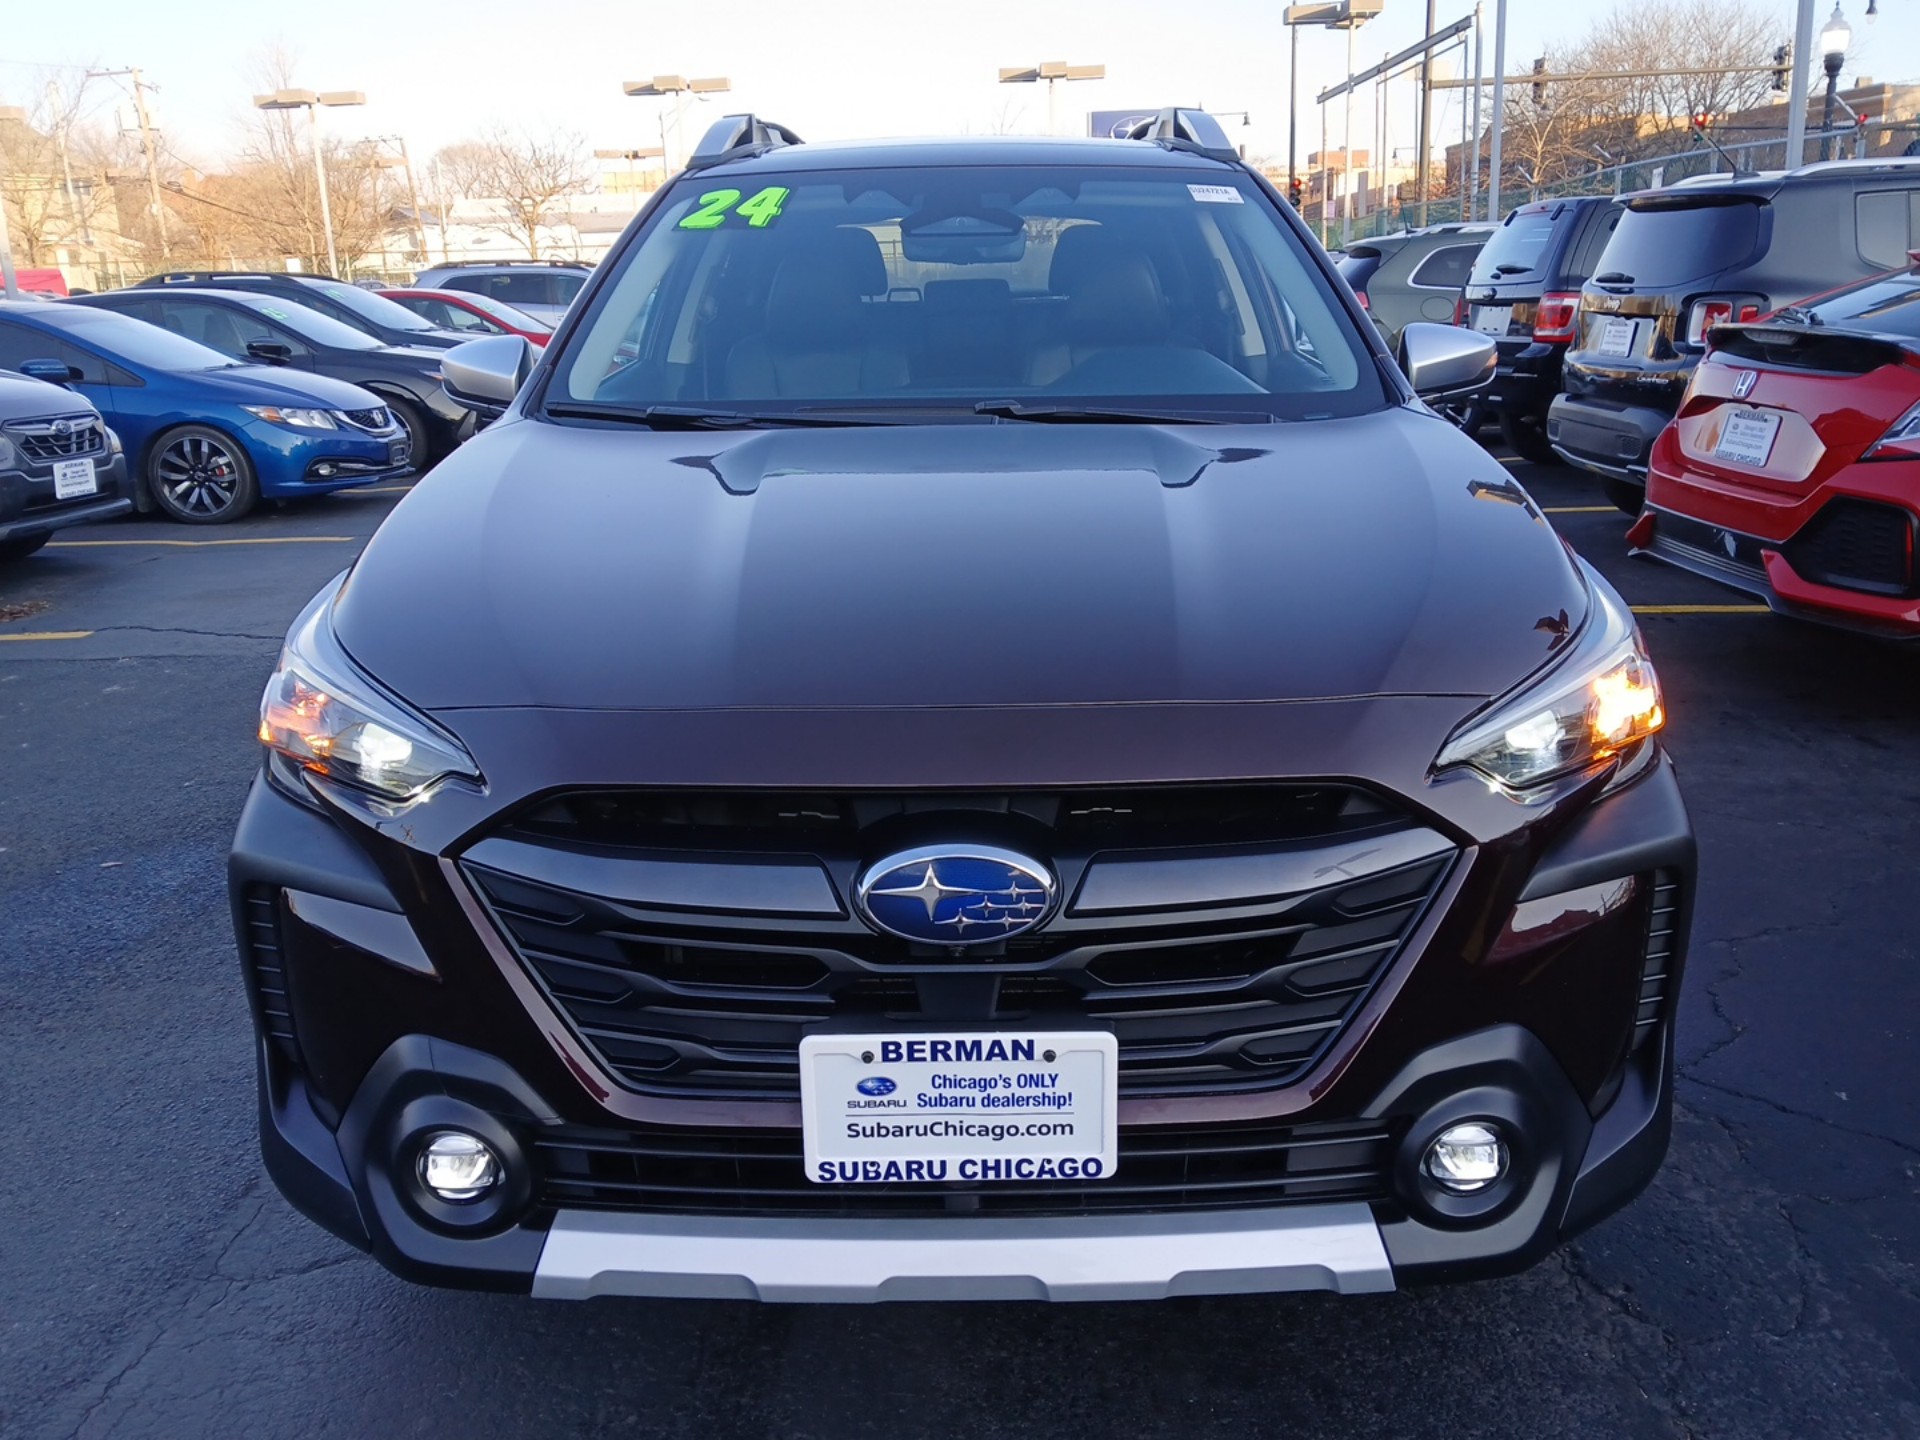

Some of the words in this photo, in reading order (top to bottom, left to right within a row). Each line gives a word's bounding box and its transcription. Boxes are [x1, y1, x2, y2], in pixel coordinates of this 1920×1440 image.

[679, 186, 790, 229] 24
[881, 1039, 1035, 1063] BERMAN
[931, 1074, 1011, 1093] Chicago's
[1016, 1073, 1059, 1089] ONLY
[847, 1100, 907, 1109] SUBARU
[917, 1092, 975, 1108] Subaru
[980, 1091, 1073, 1109] dealership!
[847, 1120, 1074, 1141] SubaruChicago.com
[818, 1159, 947, 1183] SUBARU
[958, 1157, 1103, 1180] CHICAGO
